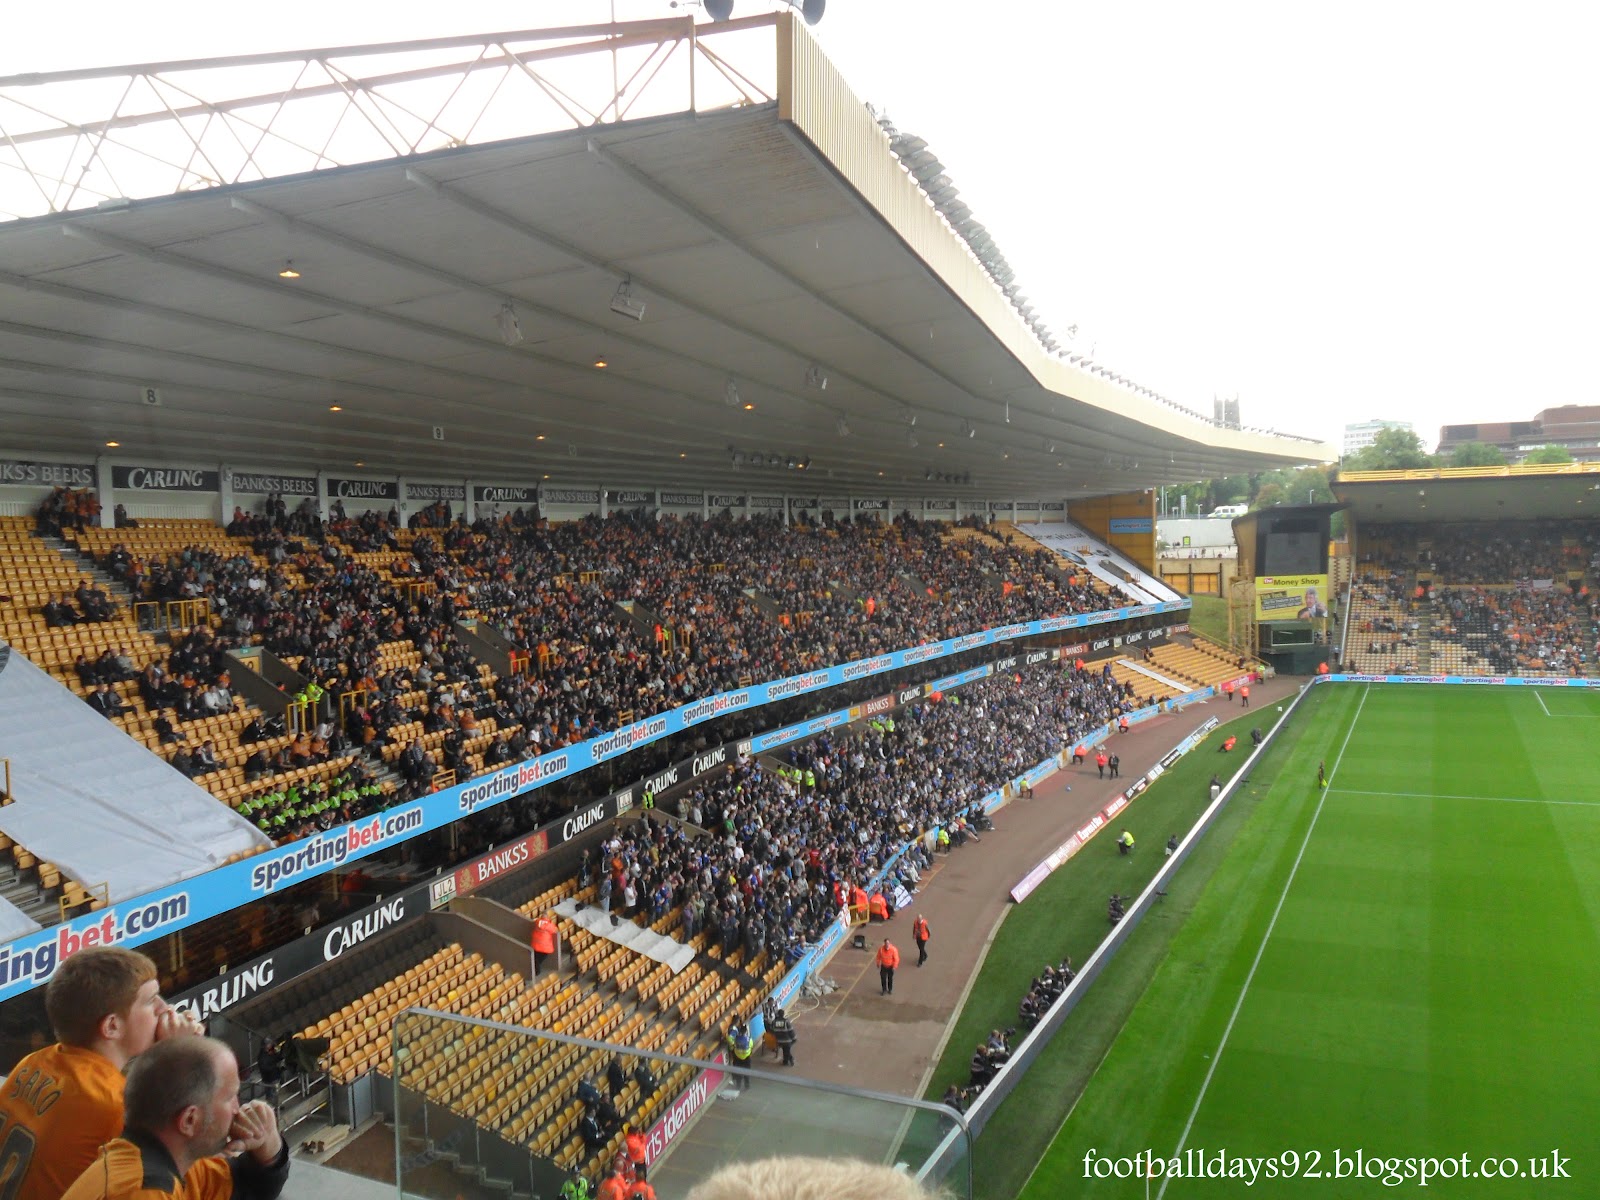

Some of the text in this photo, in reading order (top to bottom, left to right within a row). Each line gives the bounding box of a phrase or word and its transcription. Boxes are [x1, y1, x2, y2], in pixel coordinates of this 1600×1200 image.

[0, 464, 92, 484] KS'S BEERS
[128, 467, 203, 489] CARLING
[234, 477, 314, 493] BANKS'S BEERS
[337, 480, 387, 497] CARLING
[441, 487, 464, 499] BEERS
[483, 487, 527, 501] CARLING
[843, 657, 892, 678] sportingbet.com
[904, 645, 944, 663] sportingbet.com
[1026, 651, 1048, 665] CARLING
[768, 673, 829, 698] sportingbet.com
[683, 693, 748, 724] sportingbet.com
[592, 718, 666, 760] sportingbet.com
[692, 748, 725, 777] CARLING
[460, 755, 567, 809] sportingbet.com
[563, 803, 604, 841] CARLING
[253, 808, 422, 890] sportingbet.com
[478, 842, 529, 881] BANKS'S
[324, 897, 404, 961] CARLING
[10, 1068, 63, 1116] SAKO
[664, 1077, 707, 1145] identity
